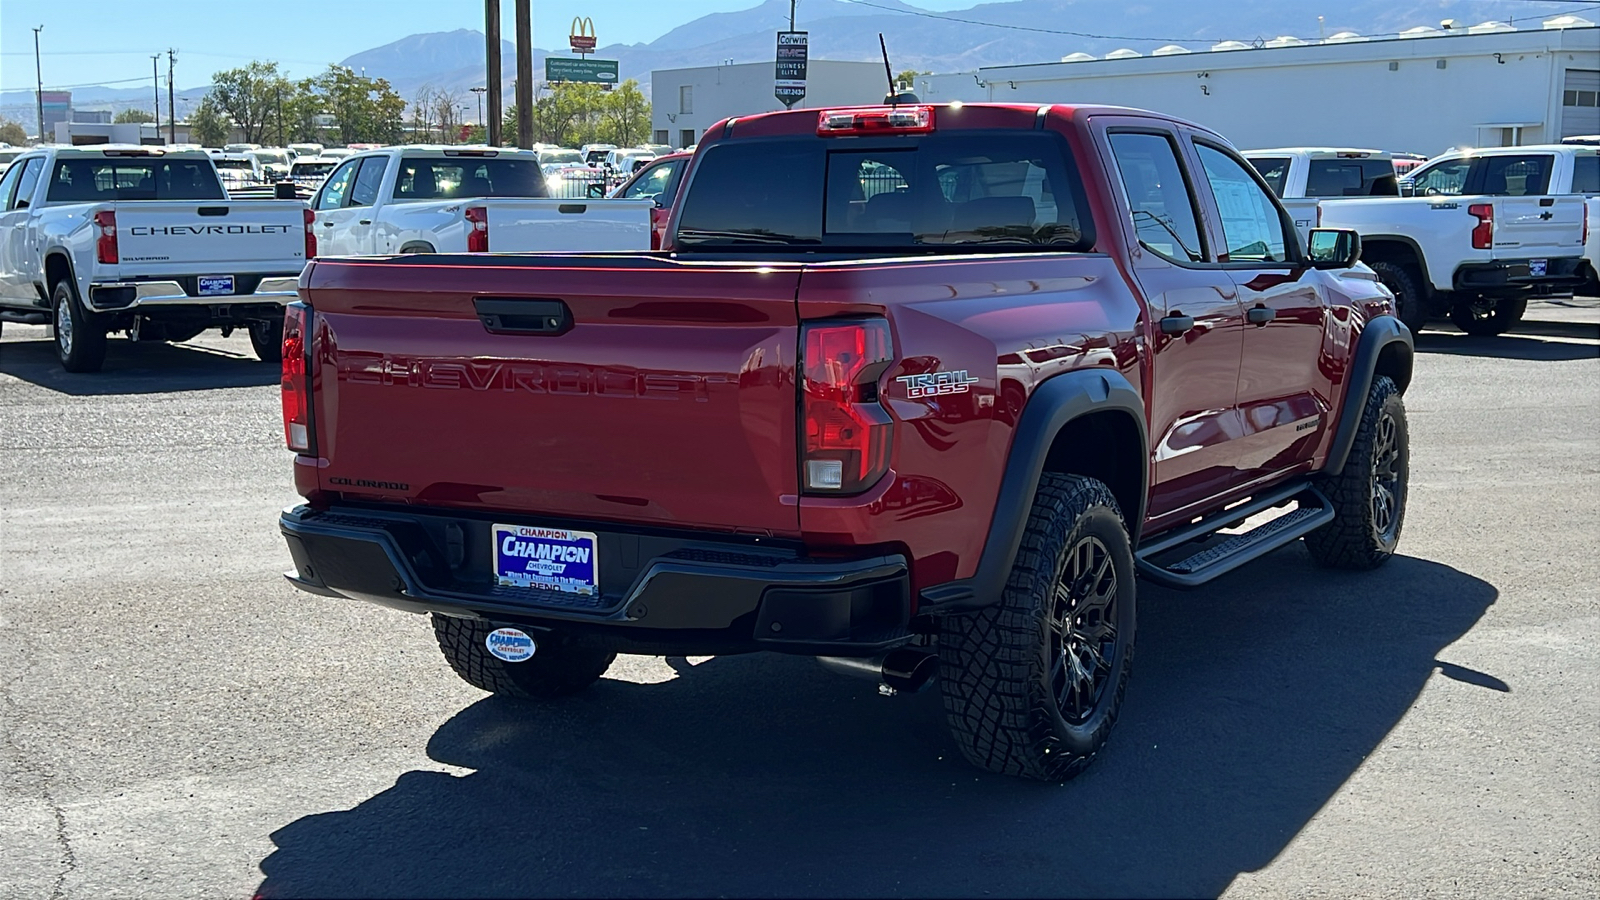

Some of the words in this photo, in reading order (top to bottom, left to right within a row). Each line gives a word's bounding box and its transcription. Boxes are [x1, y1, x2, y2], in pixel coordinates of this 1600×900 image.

[780, 35, 807, 44] Corwin
[778, 48, 806, 57] GMC
[131, 225, 292, 236] CHEVROLET
[346, 354, 728, 402] CHEVROLET
[896, 370, 979, 389] TRAIL
[907, 383, 970, 399] BOSS
[329, 476, 410, 491] COLORADO
[520, 528, 568, 540] CHAMPION
[502, 536, 590, 564] CHAMPION
[528, 562, 564, 572] CHEVROLET
